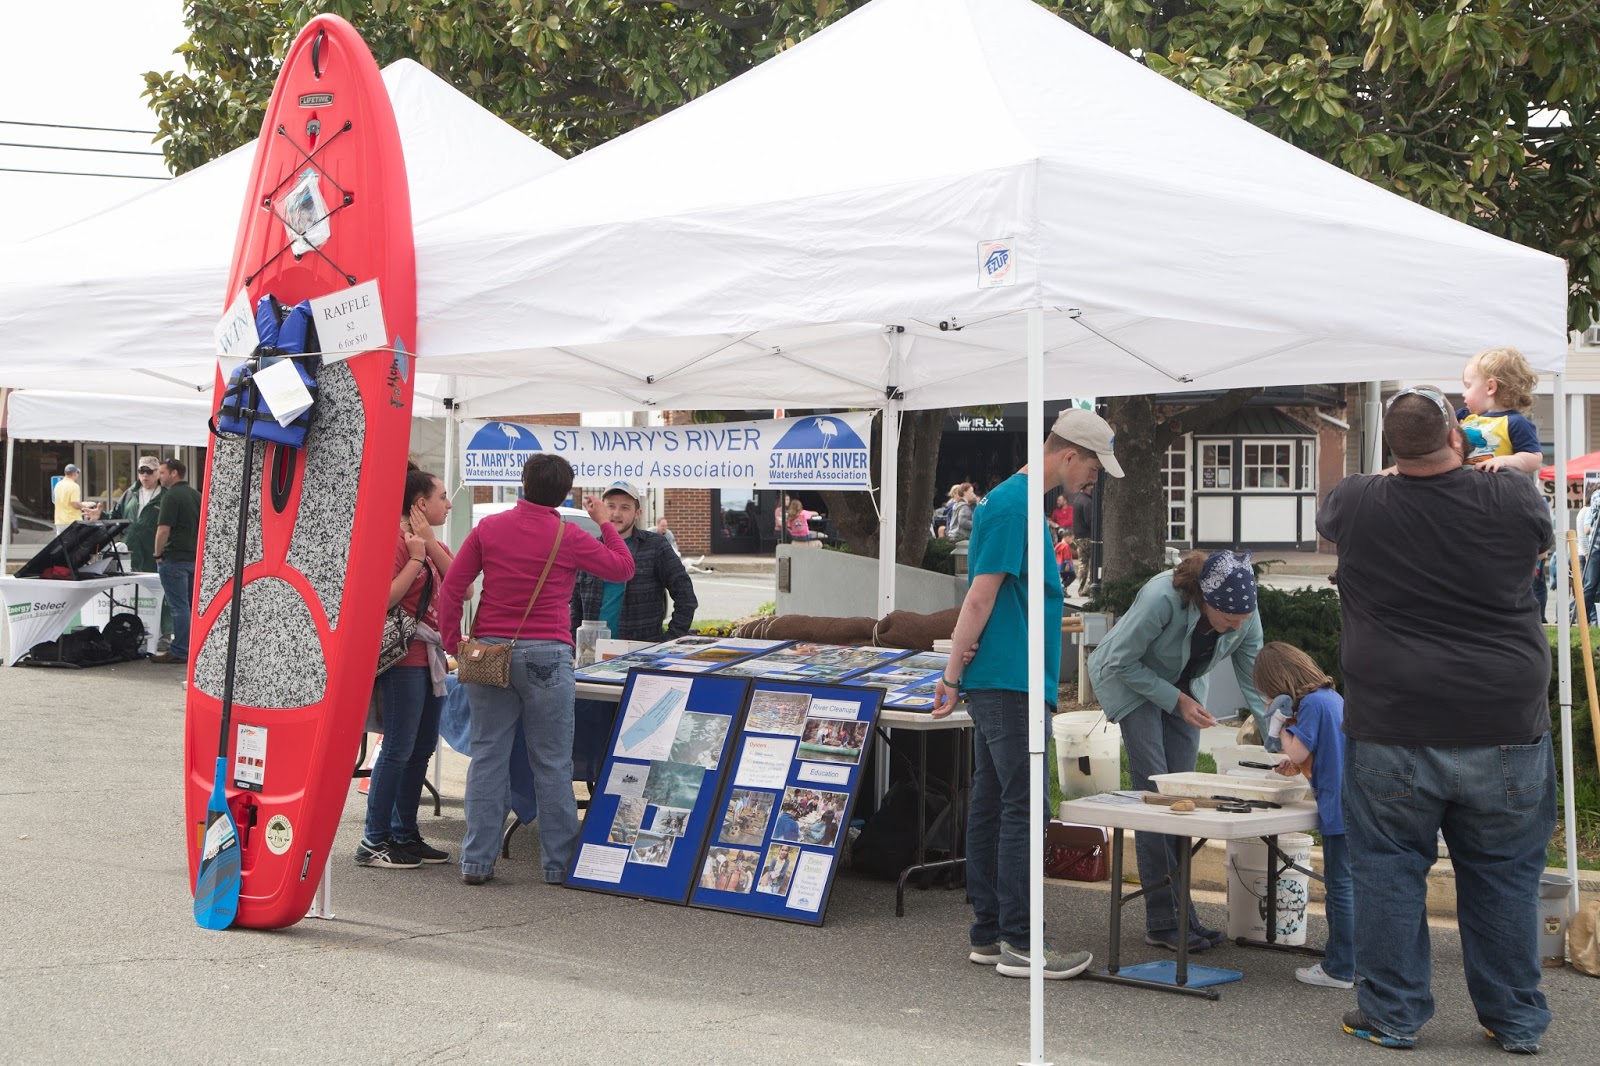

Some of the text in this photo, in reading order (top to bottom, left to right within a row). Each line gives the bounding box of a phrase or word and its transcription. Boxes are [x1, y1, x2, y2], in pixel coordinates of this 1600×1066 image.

[302, 95, 330, 104] LIFETIME
[323, 294, 371, 320] RAFFLE
[219, 309, 249, 354] WIN
[346, 321, 355, 332] $2
[338, 333, 368, 350] 6 for $10
[553, 428, 761, 452] ST. MARY'S RIVER
[465, 453, 480, 467] ST.
[481, 453, 515, 468] MARY'S
[769, 452, 867, 469] ST. MARY'S RIVER
[465, 468, 503, 477] Watershed
[573, 461, 754, 477] atershed Association
[769, 470, 867, 480] Watershed Association
[33, 601, 66, 611] Select
[812, 703, 857, 714] River Cleanups
[810, 769, 839, 778] Education
